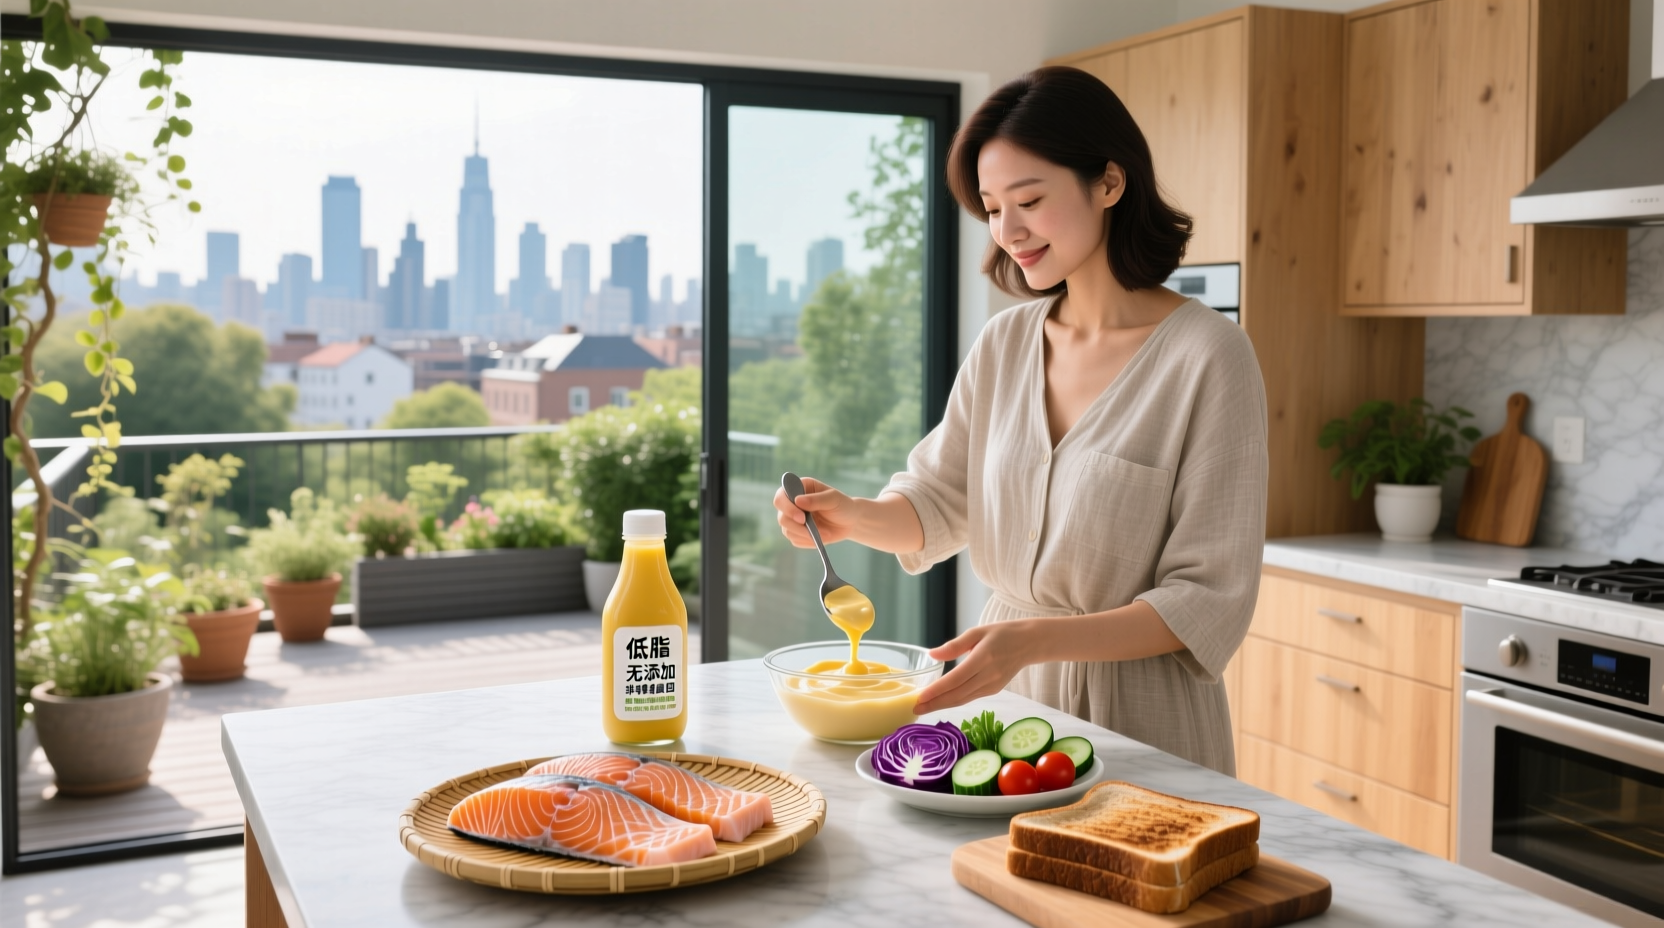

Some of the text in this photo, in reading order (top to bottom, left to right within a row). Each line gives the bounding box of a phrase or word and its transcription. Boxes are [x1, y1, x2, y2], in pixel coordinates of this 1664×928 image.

[626, 636, 670, 659] 低脂
[626, 662, 675, 682] 无添加
